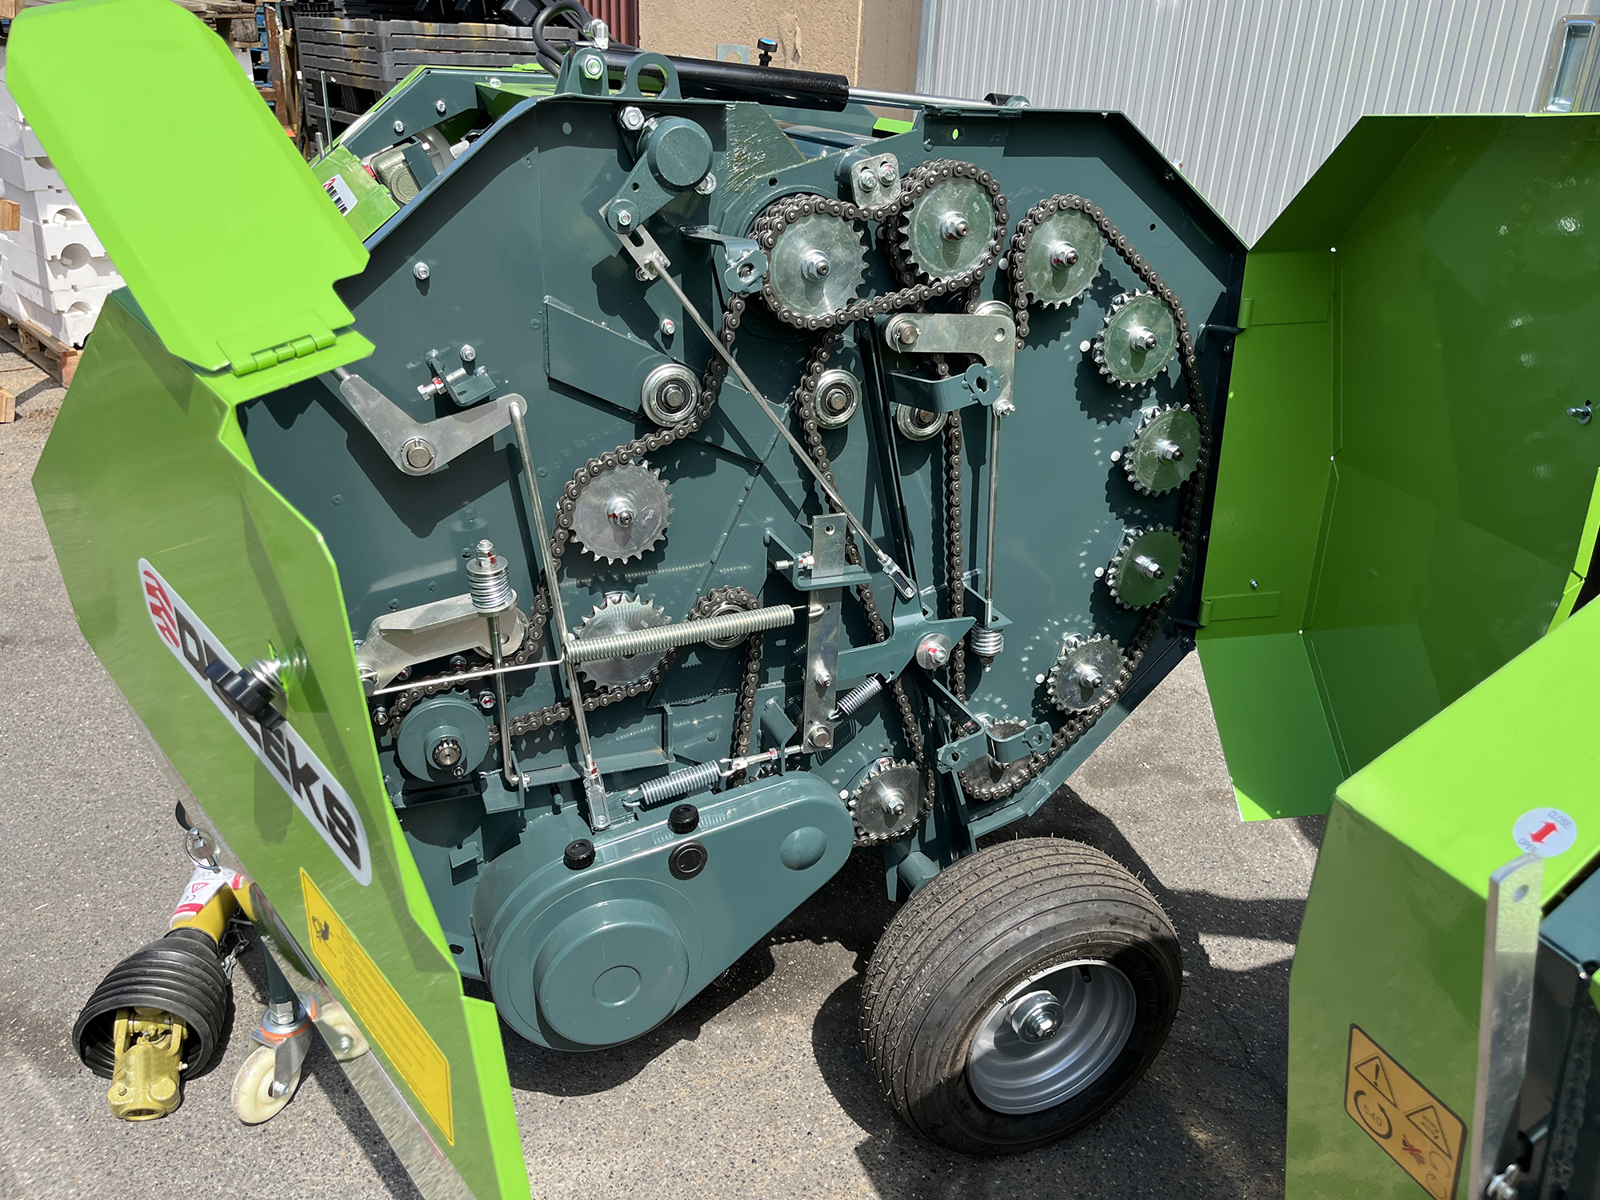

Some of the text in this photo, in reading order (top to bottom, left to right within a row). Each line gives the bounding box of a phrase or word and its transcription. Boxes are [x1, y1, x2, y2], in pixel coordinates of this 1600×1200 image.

[1547, 810, 1573, 829] CLOSE
[1518, 837, 1539, 853] OPEN
[1363, 1103, 1383, 1127] 540
